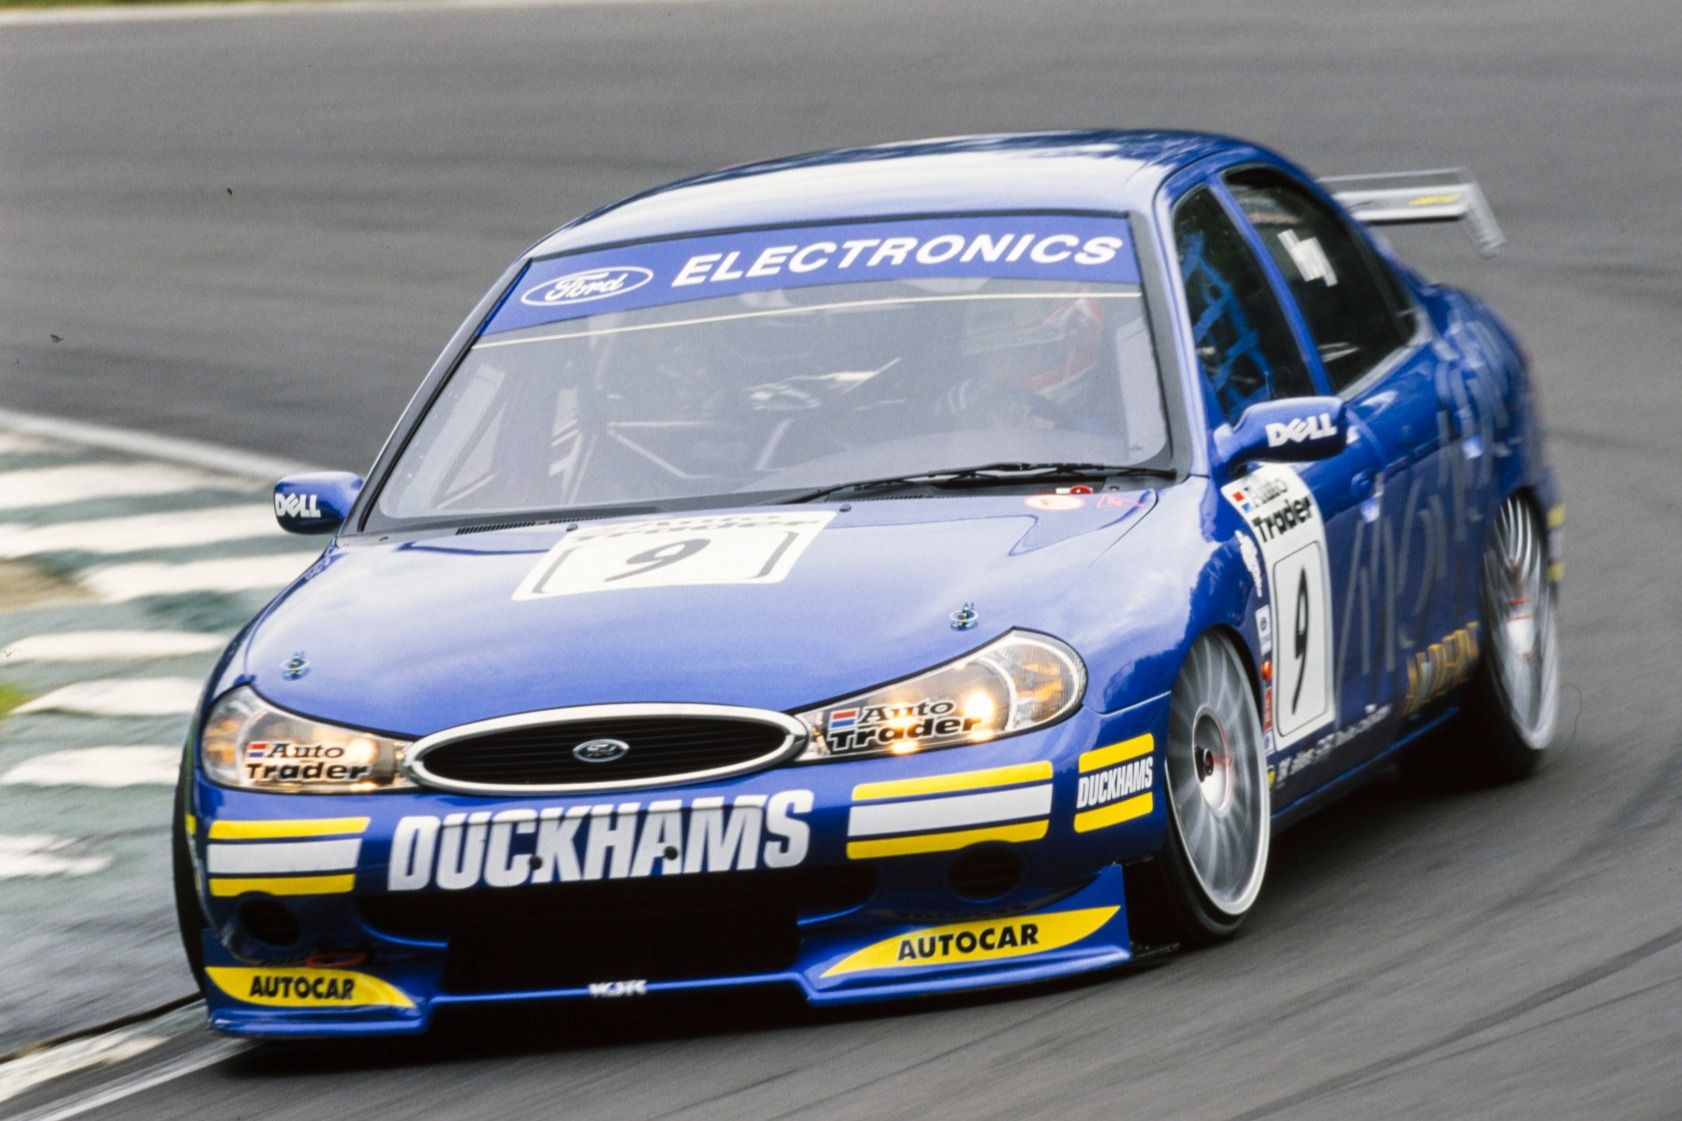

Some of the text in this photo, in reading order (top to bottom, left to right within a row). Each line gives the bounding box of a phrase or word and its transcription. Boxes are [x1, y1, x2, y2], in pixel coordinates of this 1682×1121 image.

[672, 233, 1123, 288] ELECTRONICS
[545, 269, 626, 302] Ford
[1265, 413, 1338, 447] DELL
[275, 493, 321, 518] DELL
[1252, 496, 1312, 543] Trader
[604, 538, 711, 583] 9
[1293, 565, 1309, 714] 9
[857, 701, 954, 724] Auto
[829, 717, 981, 749] Trader
[268, 743, 344, 759] Auto
[247, 763, 368, 780] Trader
[1077, 757, 1153, 808] DUCKHAMS
[388, 790, 814, 891] DUCKHAMS
[897, 923, 1038, 961] AUTOCAR
[249, 976, 355, 1000] AUTOCAR
